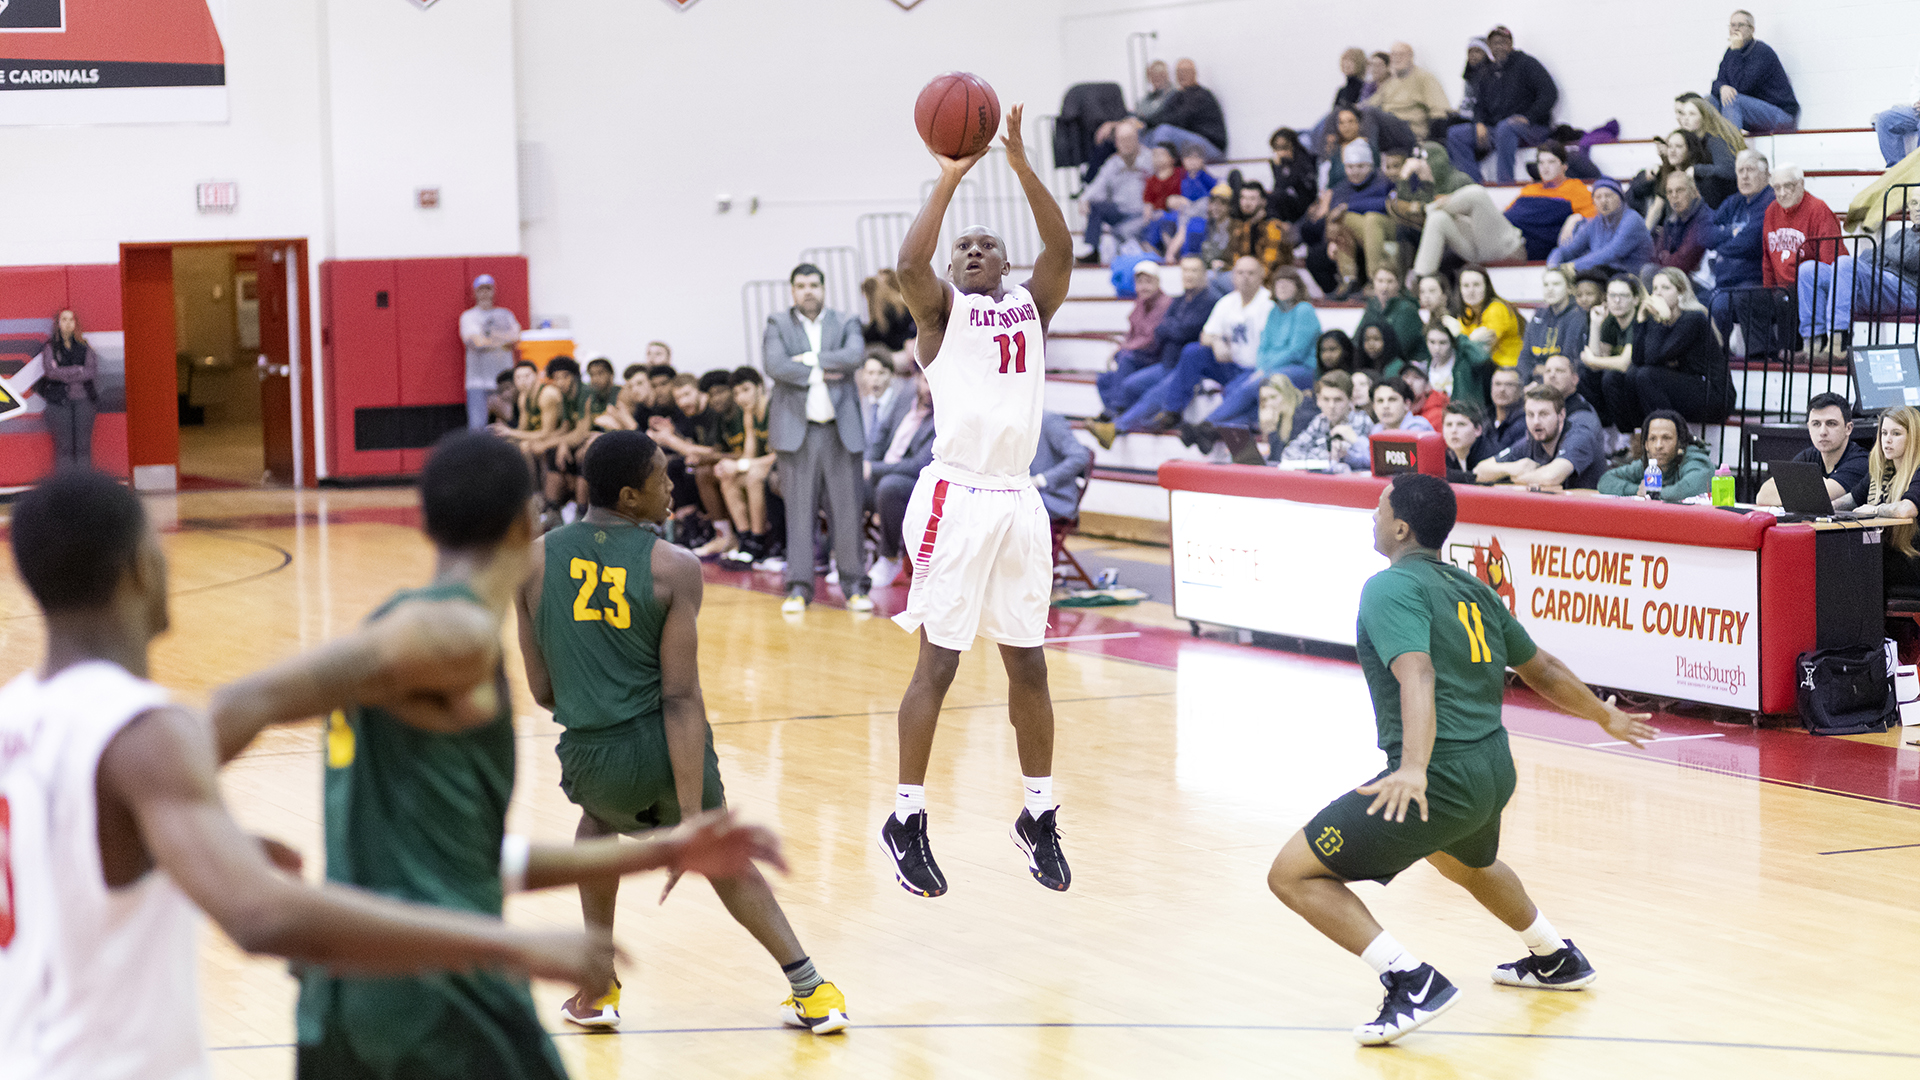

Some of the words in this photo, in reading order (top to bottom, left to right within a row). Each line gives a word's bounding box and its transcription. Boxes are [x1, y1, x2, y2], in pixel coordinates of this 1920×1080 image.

[8, 68, 100, 84] CARDINALS
[993, 331, 1026, 373] 11
[1530, 543, 1634, 587] WELCOME
[1641, 555, 1669, 589] TO
[569, 556, 631, 630] 23
[1457, 601, 1492, 663] 11
[1531, 587, 1634, 631] CARDINAL
[1642, 600, 1749, 646] COUNTRY
[1676, 655, 1746, 695] Plattsburgh
